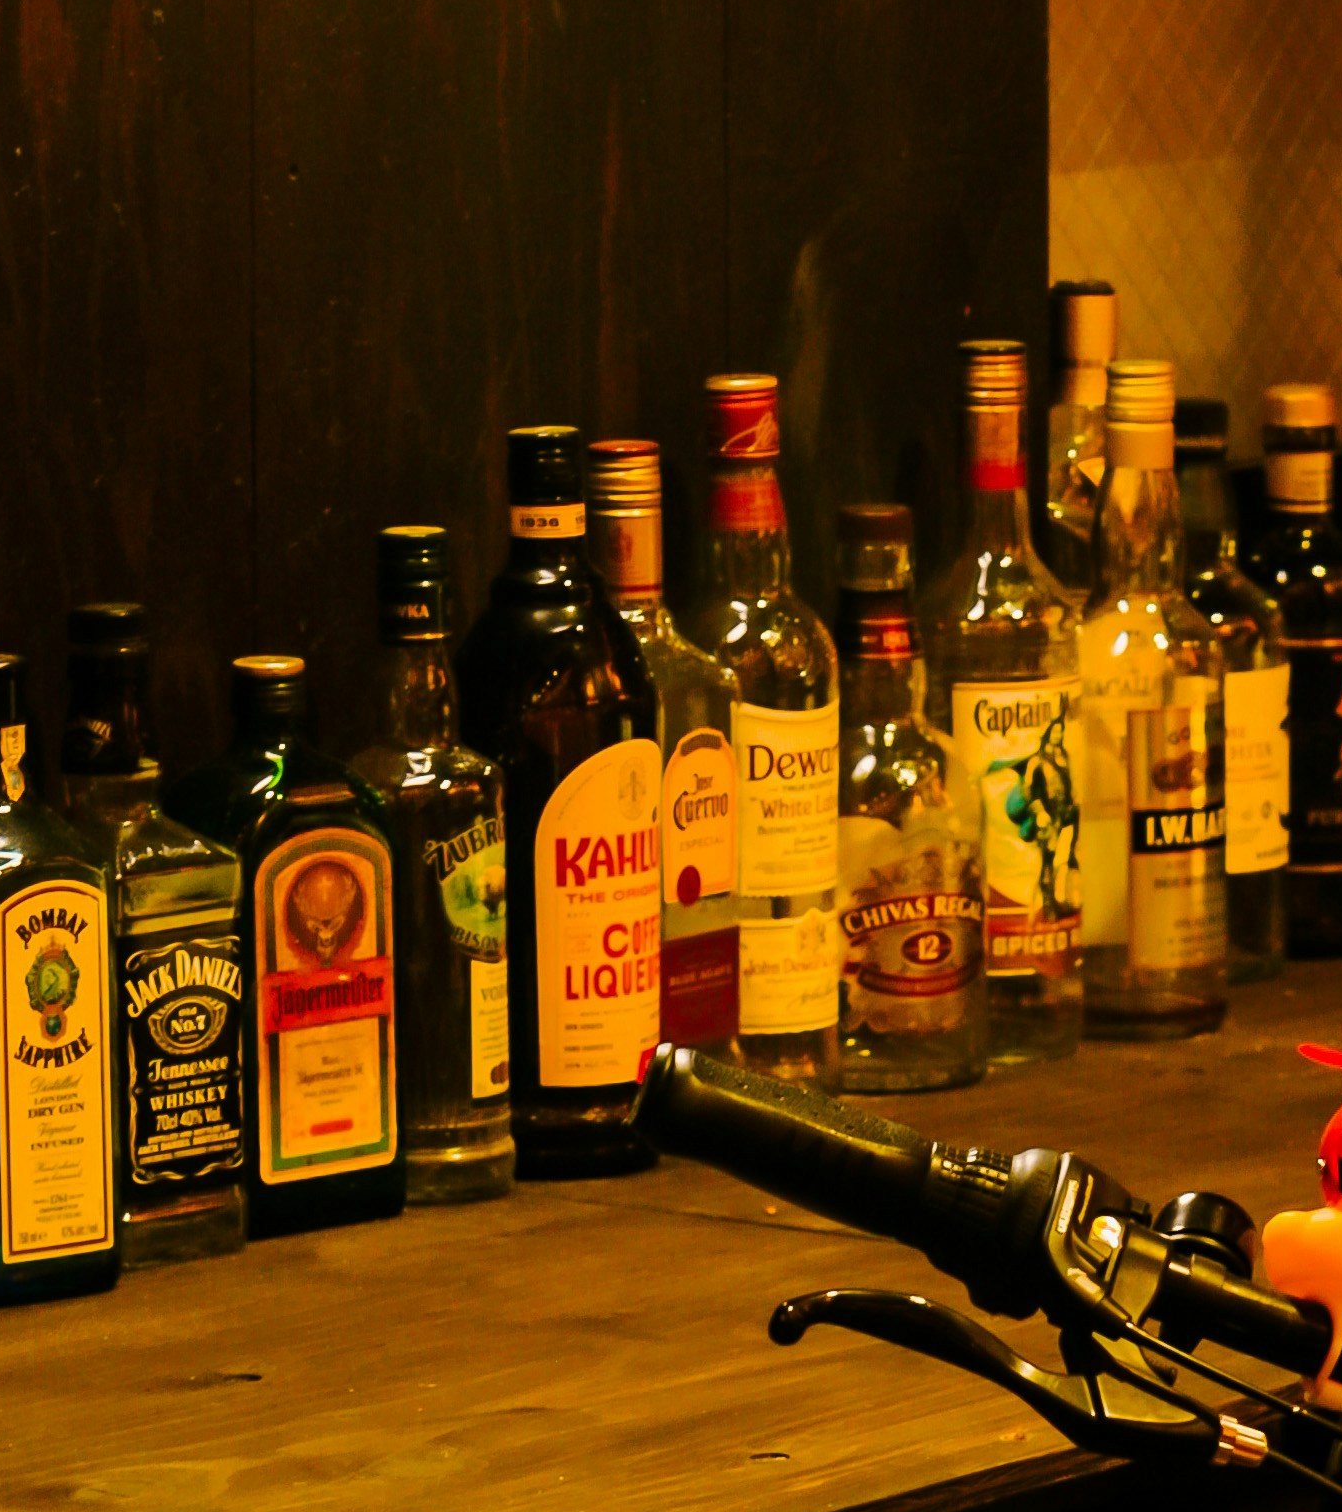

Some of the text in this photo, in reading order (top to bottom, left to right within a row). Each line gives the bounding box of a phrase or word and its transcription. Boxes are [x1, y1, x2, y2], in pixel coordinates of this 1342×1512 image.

[973, 693, 1052, 739] Captain
[672, 790, 729, 832] Cuervo
[566, 892, 606, 905] THE
[844, 896, 930, 934] CHIVAS
[15, 907, 89, 950] BOMBAY
[602, 914, 660, 959] COFF
[917, 934, 941, 961] 12
[124, 949, 242, 1019] JACK DANIEL
[13, 1026, 96, 1069] SAPPHIRE
[147, 1056, 229, 1083] Tennessee
[27, 1101, 85, 1119] DRY GIN
[149, 1084, 228, 1113] WHISKEY
[30, 1136, 85, 1152] INFUSED
